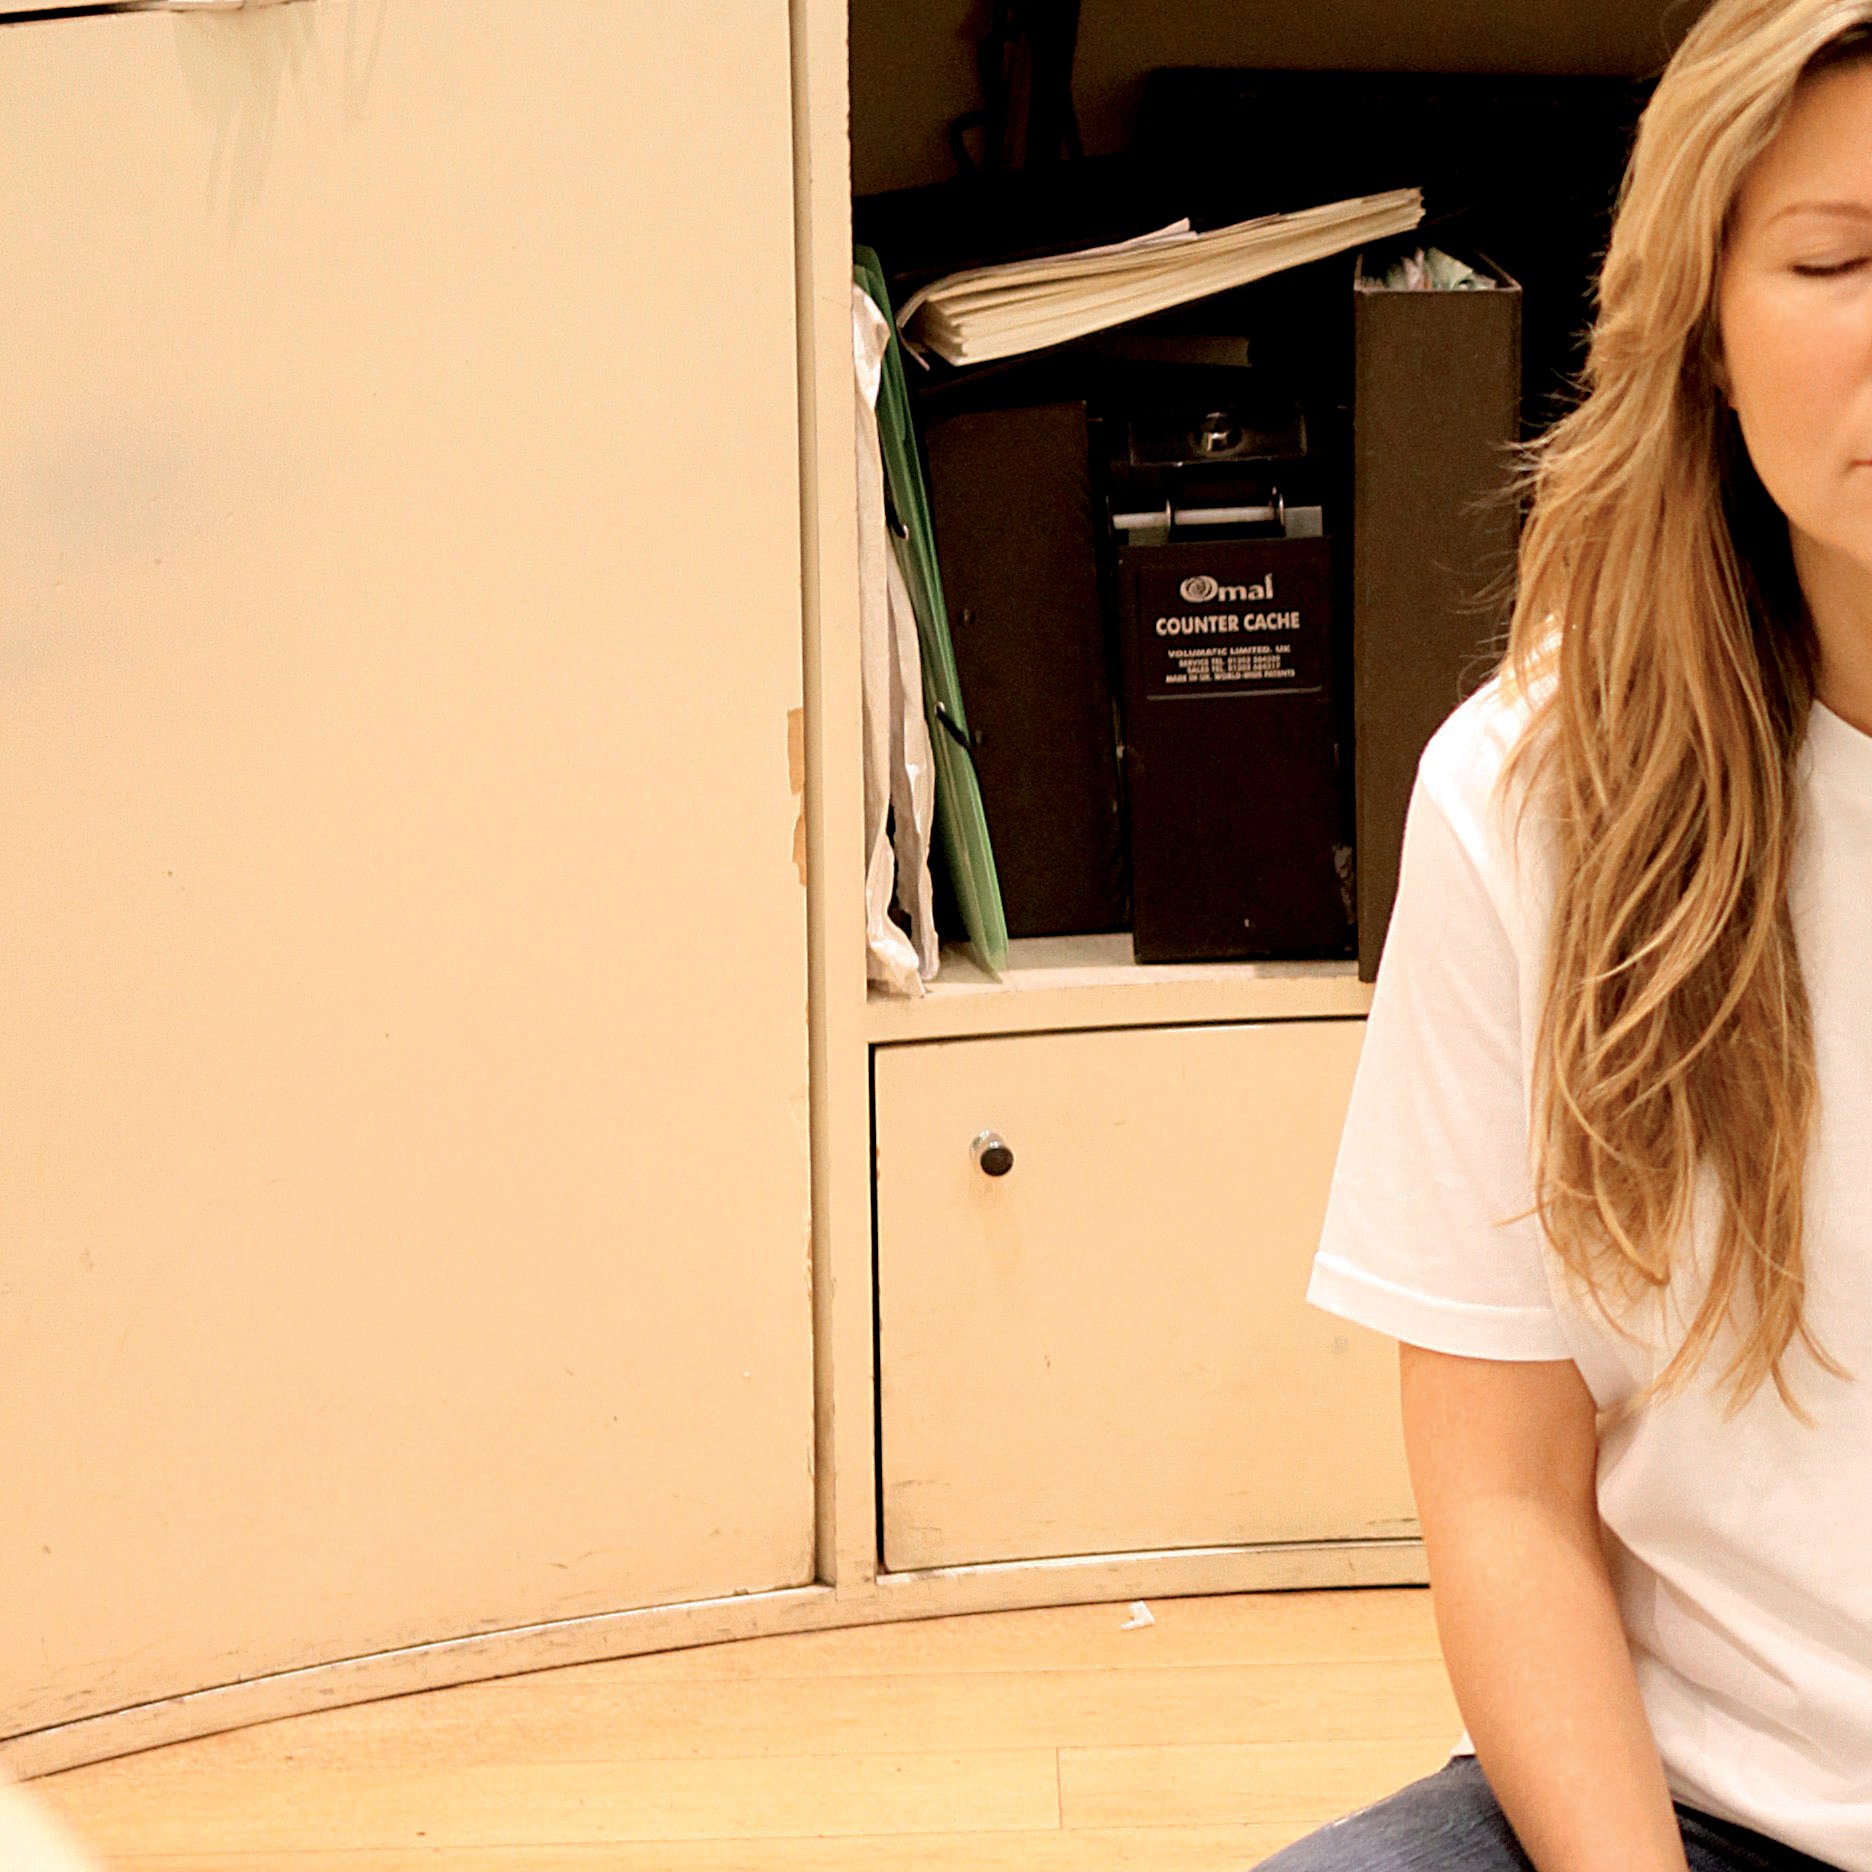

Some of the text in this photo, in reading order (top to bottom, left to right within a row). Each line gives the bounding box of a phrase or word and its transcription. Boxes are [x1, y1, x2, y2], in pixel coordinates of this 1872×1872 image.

[1179, 572, 1274, 603] Omal
[1155, 611, 1300, 636] COUNTER CACHE
[1167, 647, 1228, 659] VOLUMATIC
[1275, 644, 1292, 654] UK
